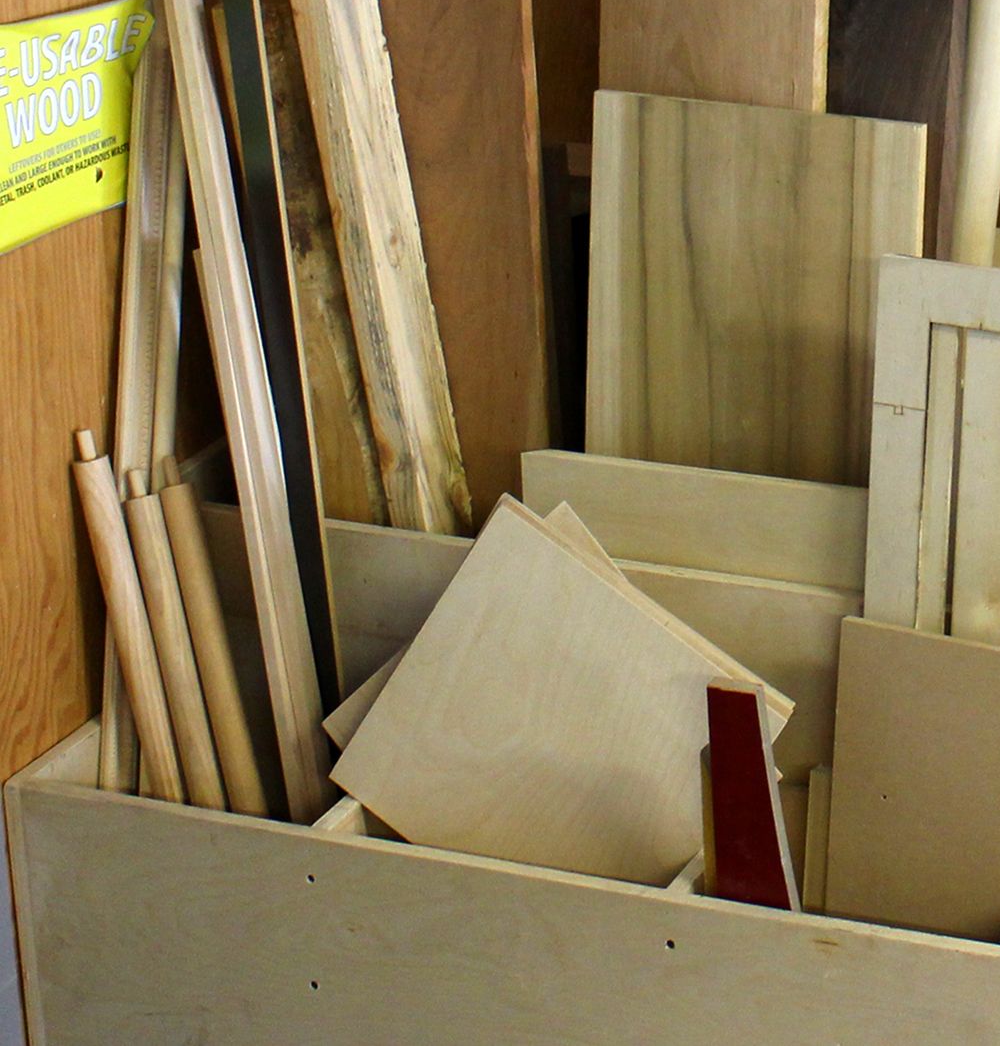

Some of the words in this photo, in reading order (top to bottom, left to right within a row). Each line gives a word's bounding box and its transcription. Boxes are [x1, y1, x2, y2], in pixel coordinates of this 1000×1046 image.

[0, 12, 147, 98] E-USABLE
[4, 71, 103, 149] WOOD
[0, 178, 14, 193] LEAN
[15, 172, 28, 184] AND
[28, 163, 48, 179] LARGE
[48, 154, 74, 170] ENOUGH
[0, 192, 16, 207] ETAL,
[65, 165, 74, 175] OR
[74, 150, 111, 170] HAZARDOUS
